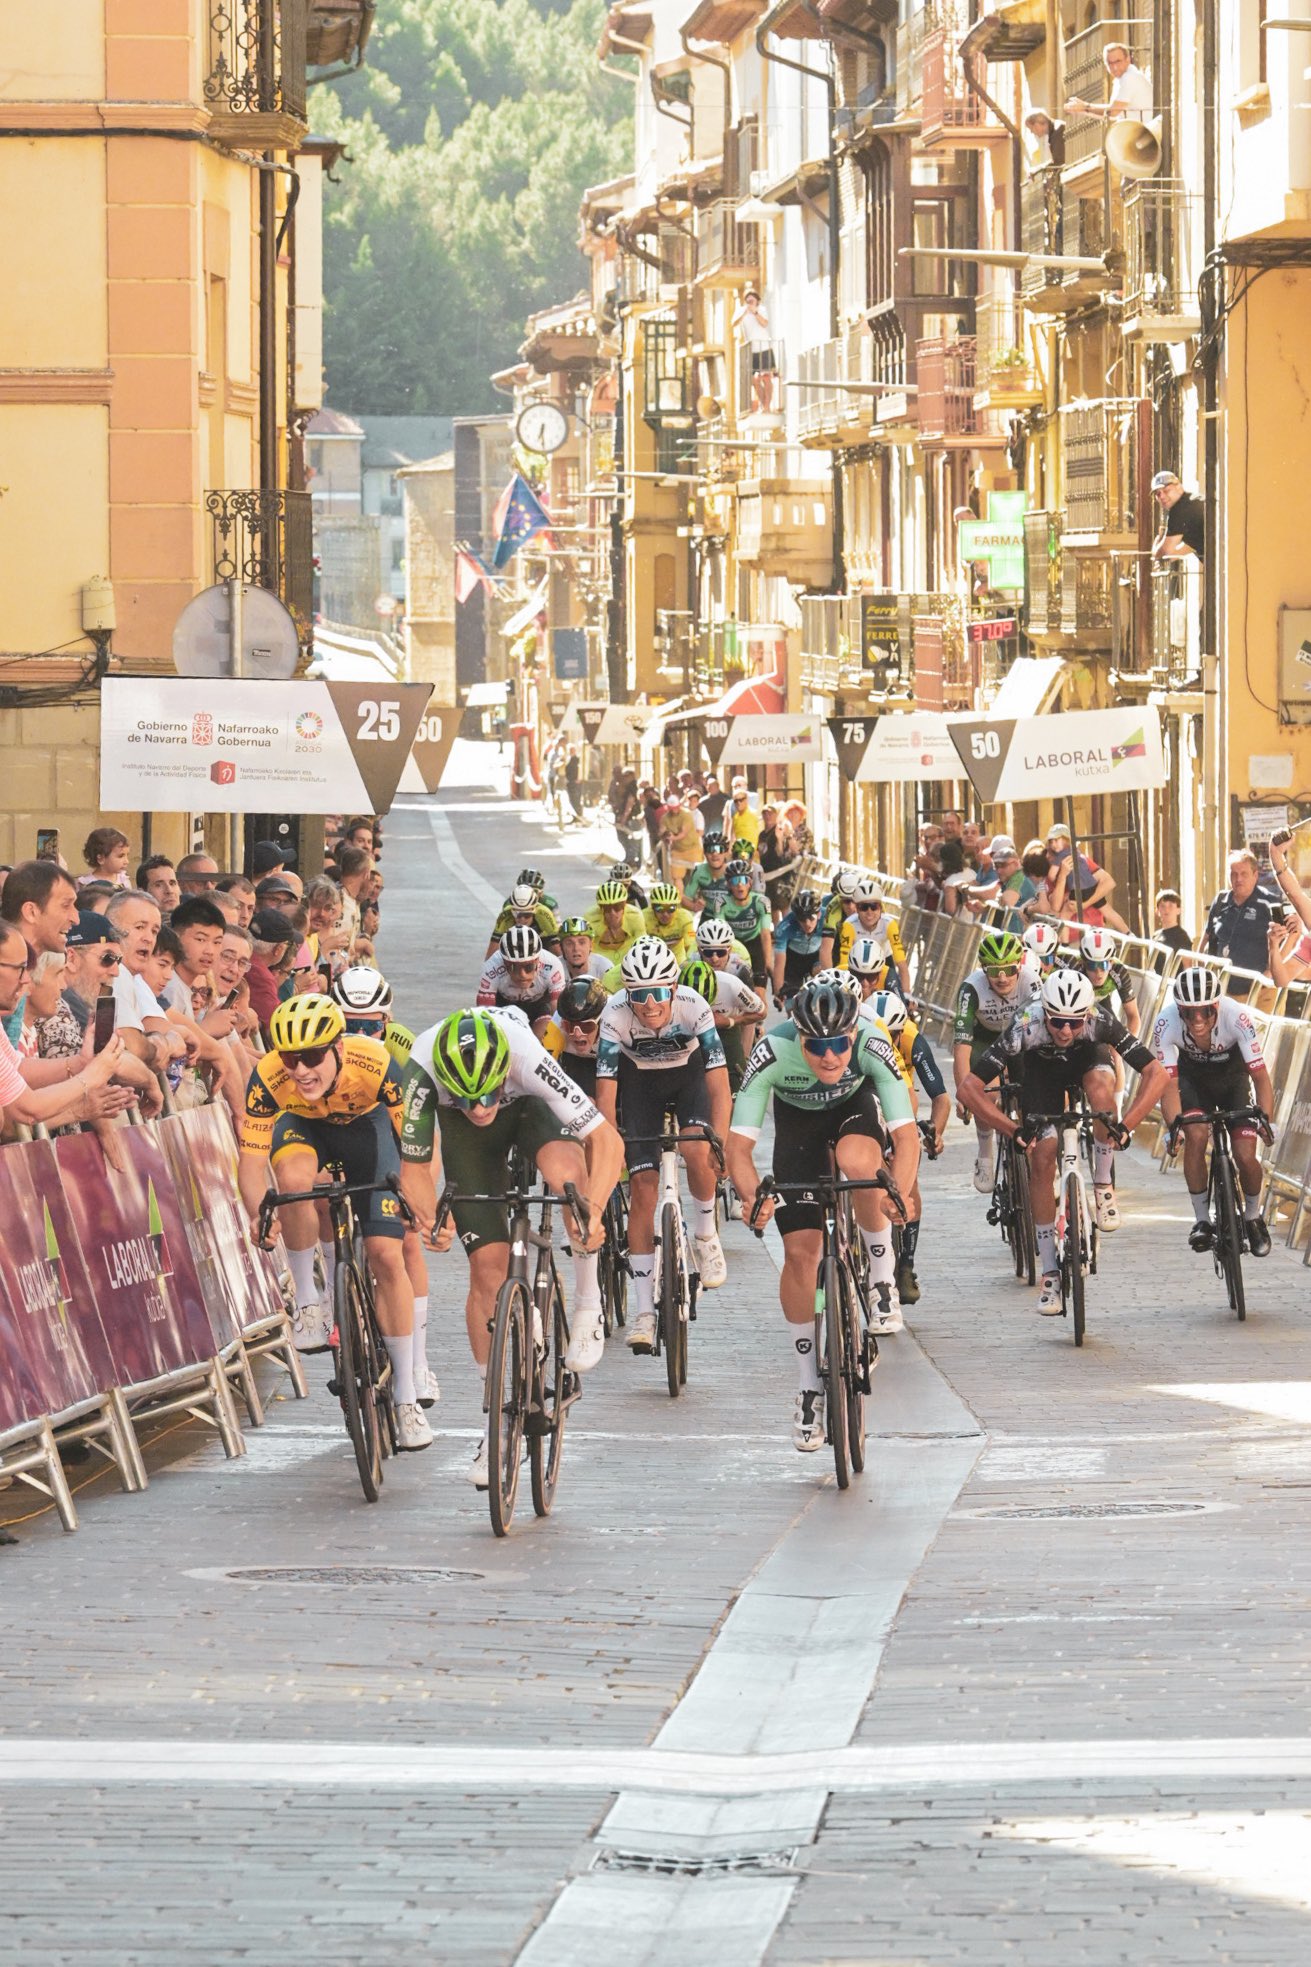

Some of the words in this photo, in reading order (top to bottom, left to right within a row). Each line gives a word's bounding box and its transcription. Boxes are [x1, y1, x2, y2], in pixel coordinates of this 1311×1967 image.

[137, 720, 188, 732] Gobierno
[218, 723, 279, 735] Nafarroako
[356, 700, 400, 742] 25
[704, 721, 728, 738] 100
[128, 733, 142, 743] de
[144, 734, 188, 745] Navarra
[217, 736, 271, 748] Gobernua
[738, 736, 788, 747] LABORAL
[842, 722, 865, 744] 75
[295, 745, 322, 753] 2030
[970, 730, 1000, 760] 50
[1024, 748, 1108, 771] LABORAL
[1075, 764, 1111, 777] kutxa
[962, 993, 971, 1017] RGA
[534, 1063, 569, 1099] RGA
[542, 1057, 575, 1090] SEGUROS
[409, 1087, 431, 1121] RGA
[102, 1236, 155, 1290] LABORAL
